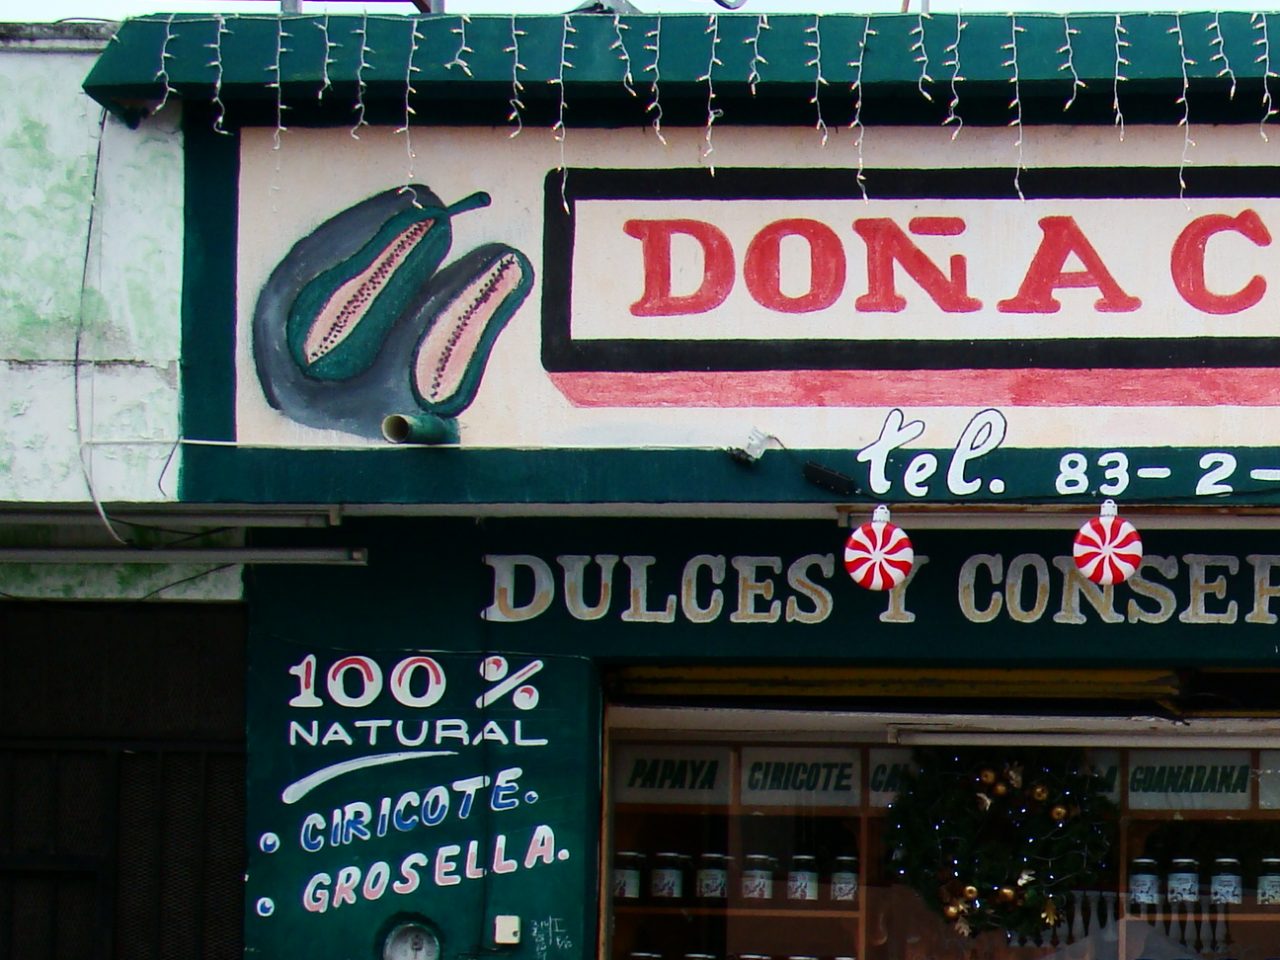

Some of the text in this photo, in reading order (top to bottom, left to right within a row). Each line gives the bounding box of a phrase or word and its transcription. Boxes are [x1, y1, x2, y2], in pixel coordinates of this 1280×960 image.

[623, 214, 1142, 317] DOÑA
[855, 408, 1005, 496] tel.
[481, 553, 834, 624] DULCES
[868, 555, 930, 623] Y
[289, 654, 544, 710] 100 %
[289, 719, 549, 747] NATURAL
[301, 767, 540, 852] CIRICOTE.
[628, 758, 720, 791] PAPAYA
[748, 761, 853, 791] CIRICOTE
[303, 825, 570, 914] GROSELLA.
